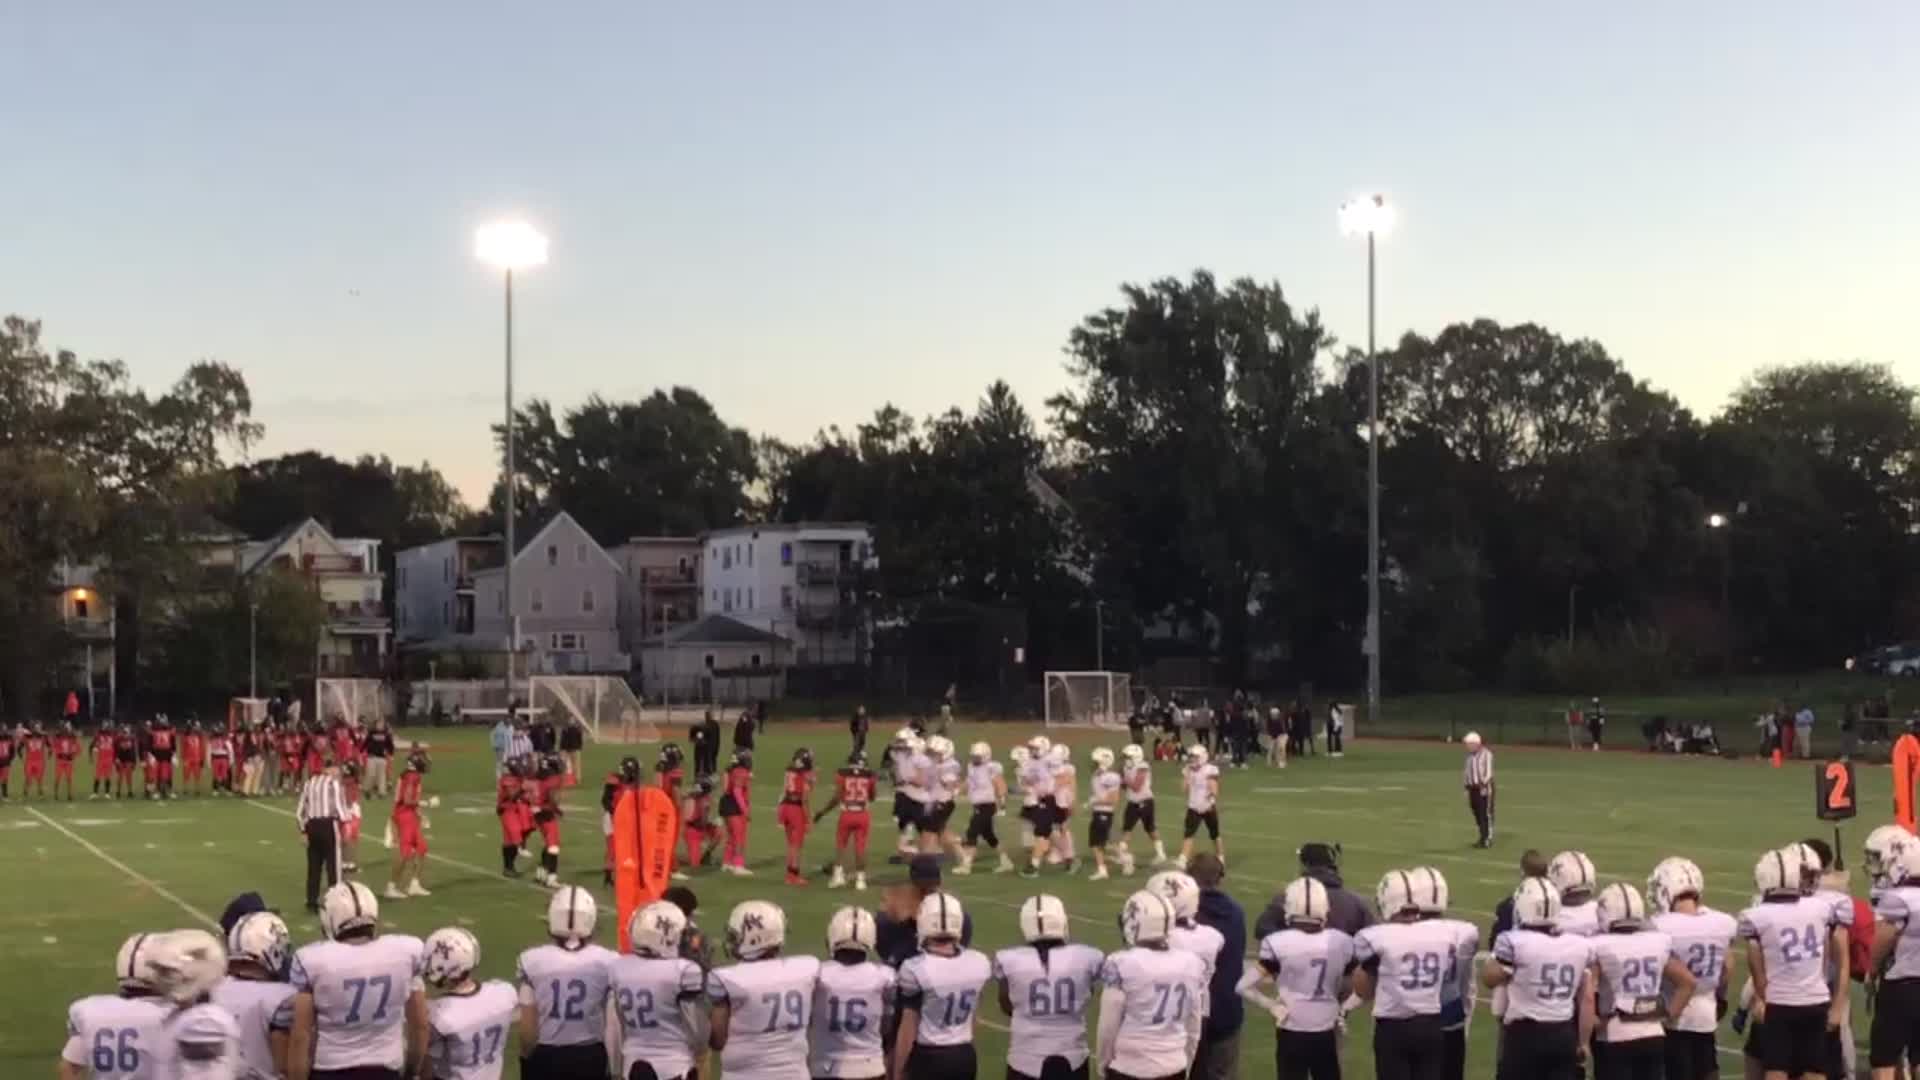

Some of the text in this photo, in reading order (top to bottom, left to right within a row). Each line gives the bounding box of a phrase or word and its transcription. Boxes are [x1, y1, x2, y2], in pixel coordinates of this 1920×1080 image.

[1825, 761, 1851, 809] 2
[1688, 943, 1717, 977] 21
[1781, 924, 1821, 963] 24
[1309, 958, 1327, 997] 7
[1401, 951, 1440, 990] 39
[1537, 963, 1575, 1000] 59
[1621, 957, 1658, 994] 25
[343, 974, 392, 1024] 77
[551, 978, 587, 1020] 12
[620, 988, 659, 1029] 22
[761, 991, 802, 1033] 79
[827, 997, 868, 1034] 16
[941, 990, 972, 1027] 15
[1028, 977, 1075, 1017] 60
[93, 1028, 140, 1073] 66
[471, 1024, 502, 1067] 17
